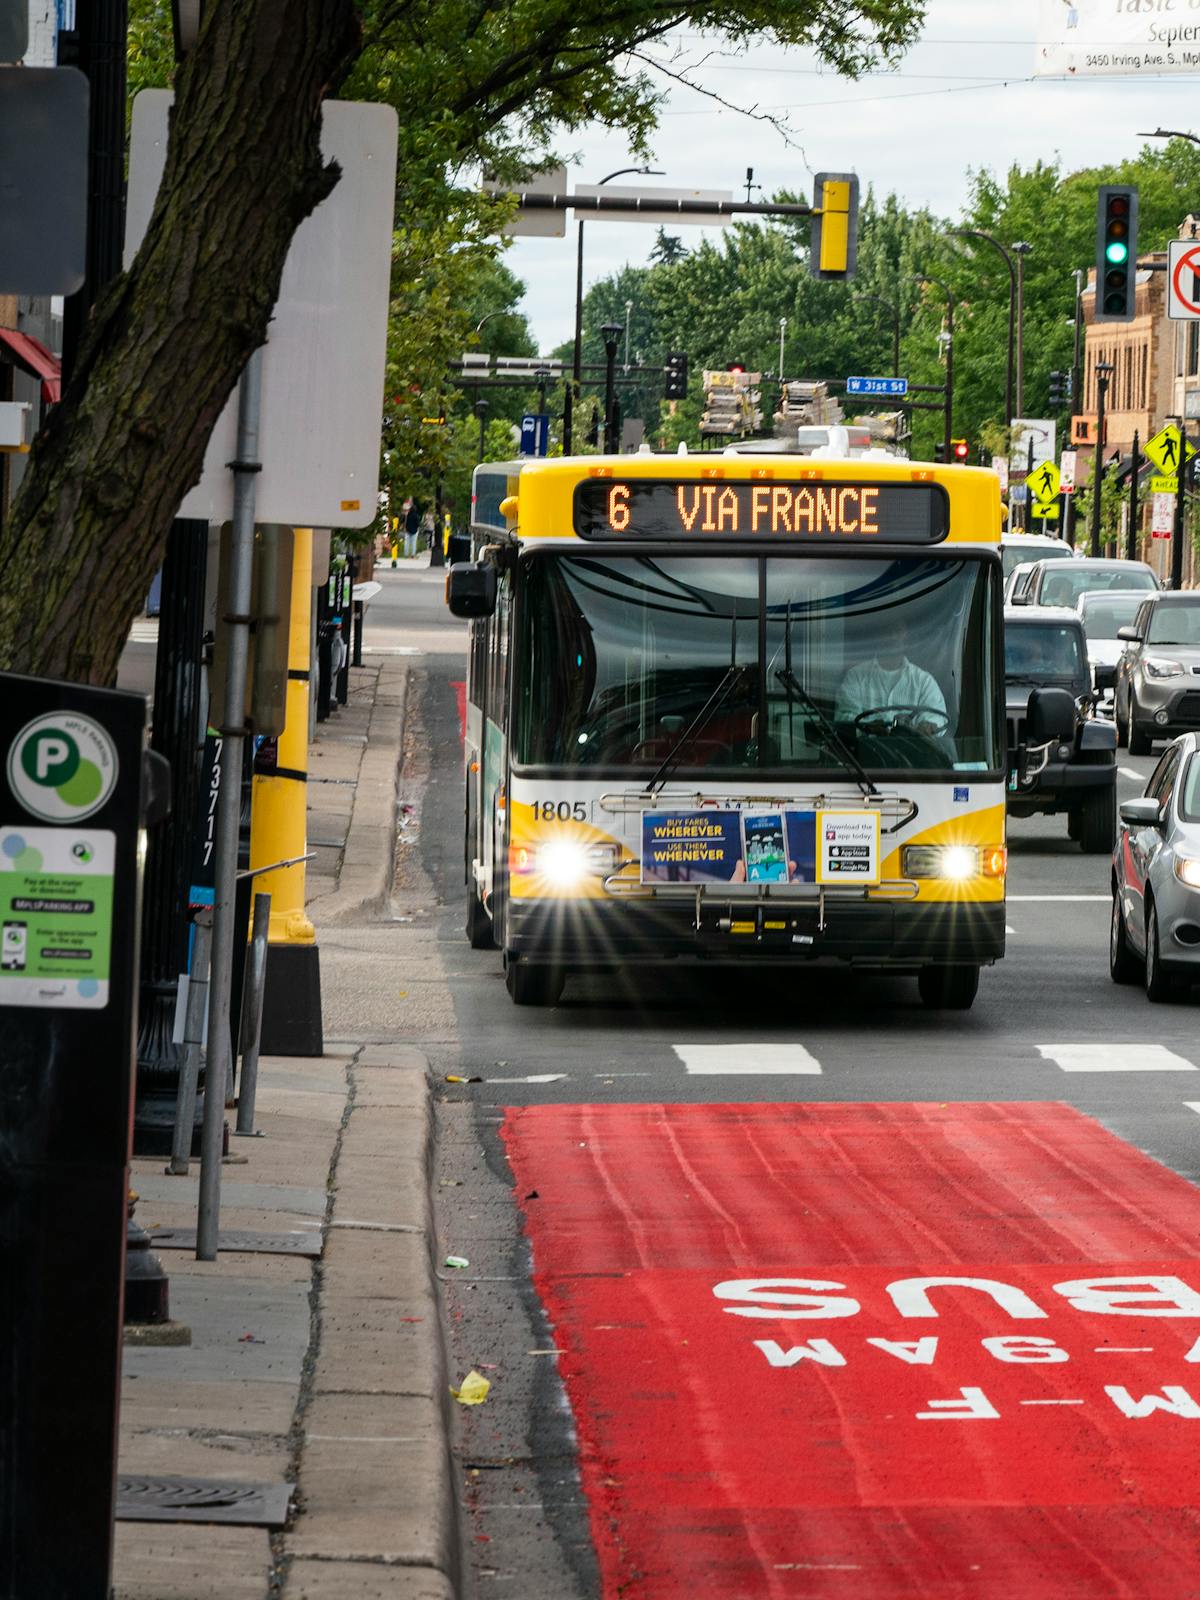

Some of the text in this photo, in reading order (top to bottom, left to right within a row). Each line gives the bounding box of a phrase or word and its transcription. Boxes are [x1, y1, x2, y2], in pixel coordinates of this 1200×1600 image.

[1086, 54, 1109, 67] 3450
[1112, 54, 1140, 69] Irving
[1144, 54, 1166, 66] Ave.
[851, 380, 904, 392] W 31st St
[609, 485, 880, 533] 6 VIA FRANCE
[37, 738, 69, 779] P
[530, 800, 587, 822] 1805
[666, 817, 709, 827] BUY FARES
[653, 825, 723, 838] WHEREVER
[667, 842, 707, 851] USE THEM
[653, 849, 724, 862] WHENEVER
[753, 1335, 940, 1368] AM
